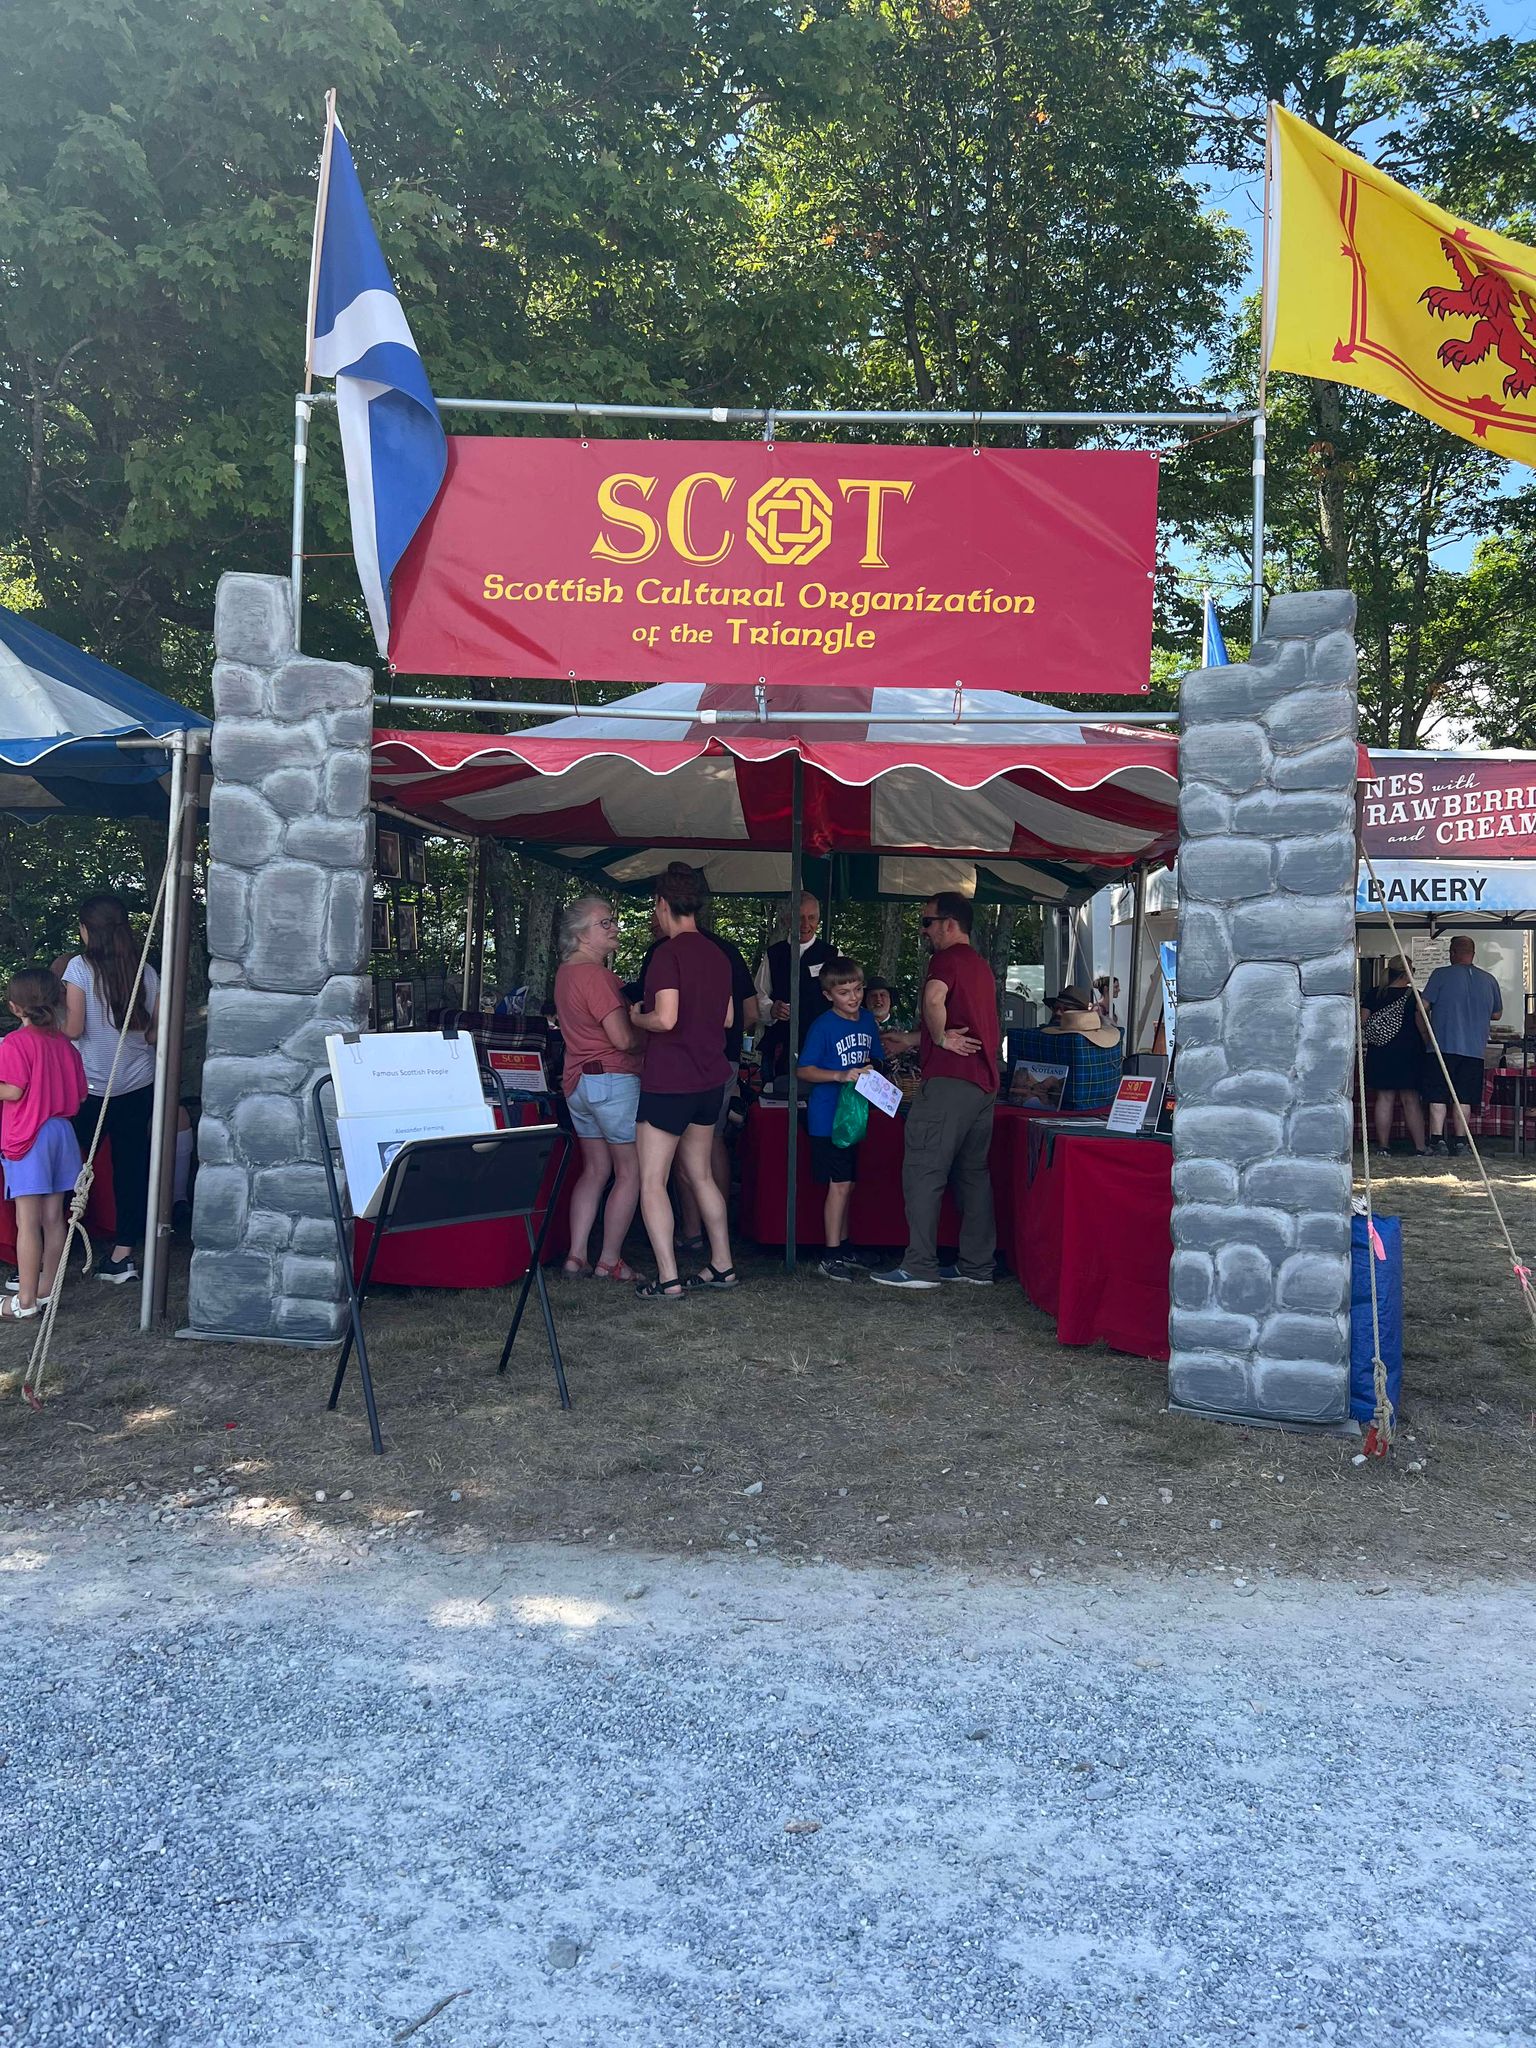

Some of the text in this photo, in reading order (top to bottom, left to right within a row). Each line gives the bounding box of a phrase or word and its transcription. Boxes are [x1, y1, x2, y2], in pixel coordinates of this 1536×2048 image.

[591, 471, 915, 569] SCOT
[482, 574, 1036, 618] Scottish Cultural Organization
[631, 618, 877, 655] of the Triangle
[1431, 772, 1481, 792] with
[1363, 786, 1536, 828] RAWBERRI
[1387, 825, 1427, 843] and
[1367, 877, 1488, 903] BAKERY
[836, 1033, 857, 1056] BLUE
[400, 1068, 426, 1076] Scottish
[427, 1068, 449, 1076] People
